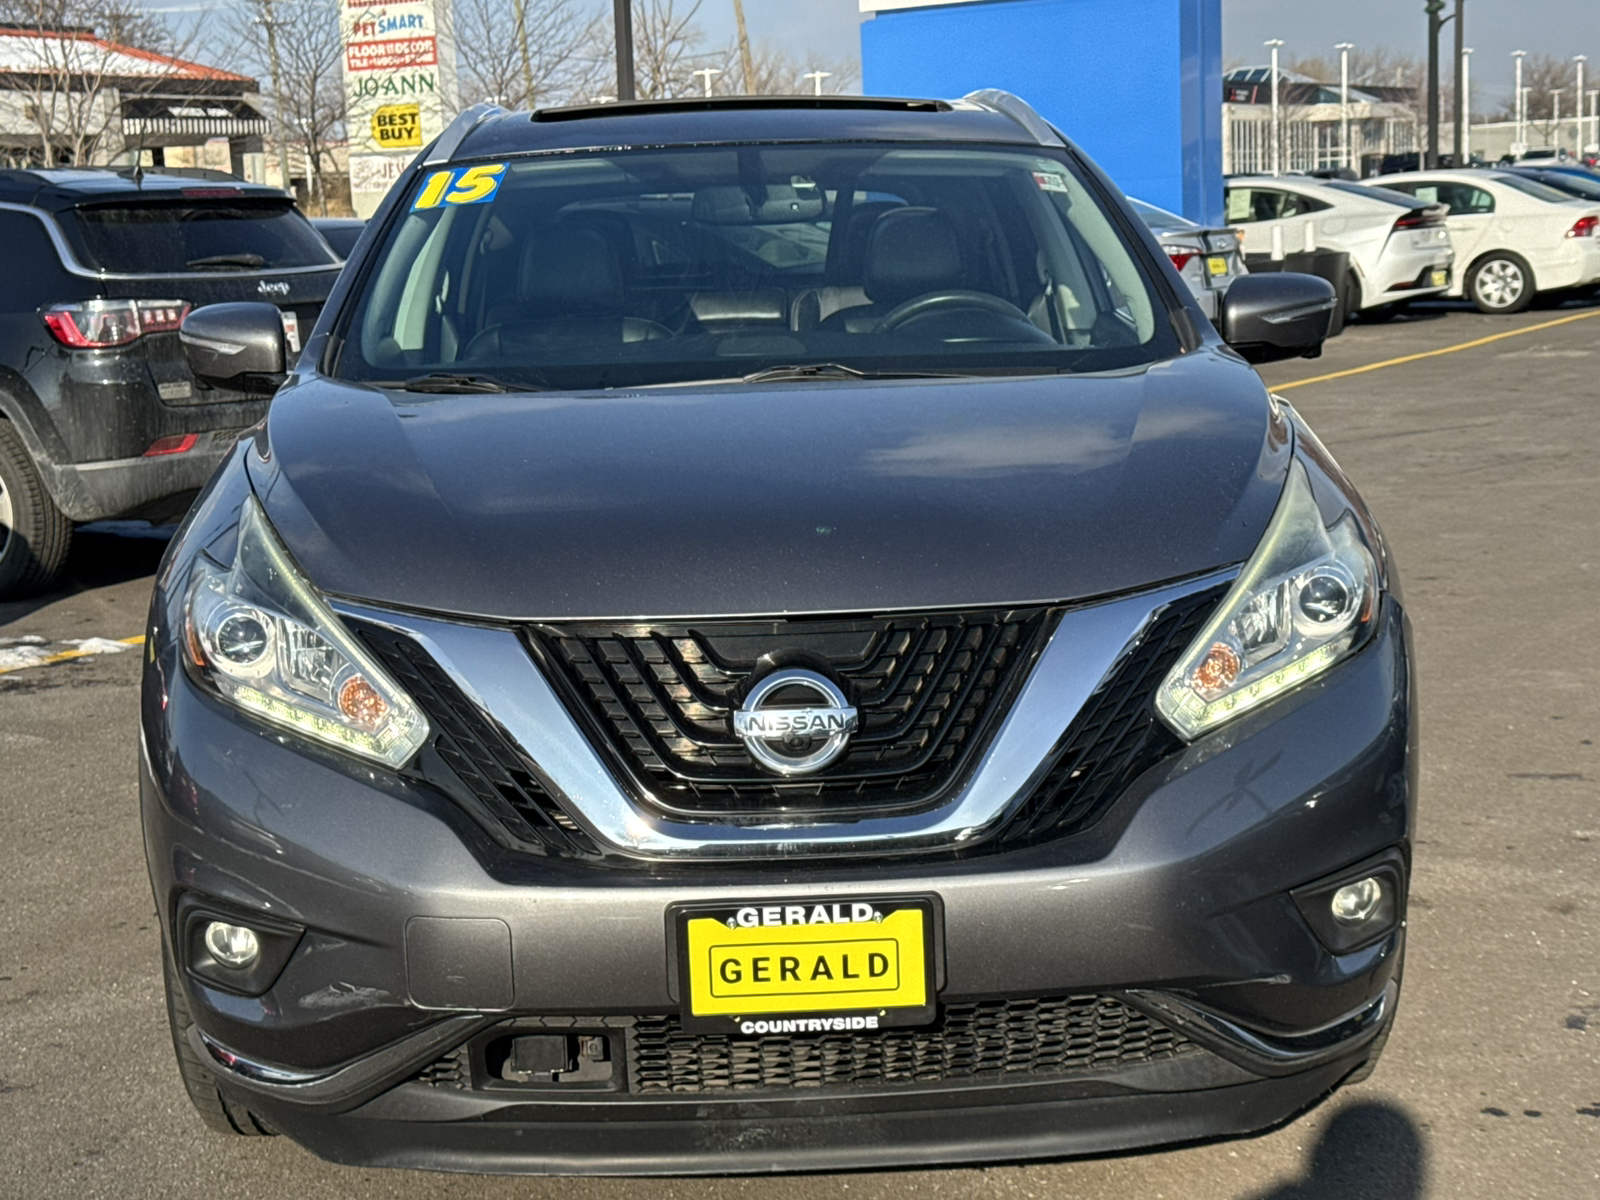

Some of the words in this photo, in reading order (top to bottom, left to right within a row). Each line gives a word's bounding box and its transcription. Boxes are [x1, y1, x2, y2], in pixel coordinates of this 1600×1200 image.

[353, 13, 424, 37] PETSMART
[348, 43, 386, 58] FLOOR
[353, 73, 435, 98] JOANN
[377, 112, 419, 127] BEST
[380, 127, 415, 141] BUY
[414, 163, 506, 210] 15
[257, 279, 290, 296] Jeep
[748, 713, 845, 732] NISSAN
[736, 902, 874, 928] GERALD
[719, 952, 889, 984] GERALD
[740, 1016, 879, 1035] COUNTRYSIDE
